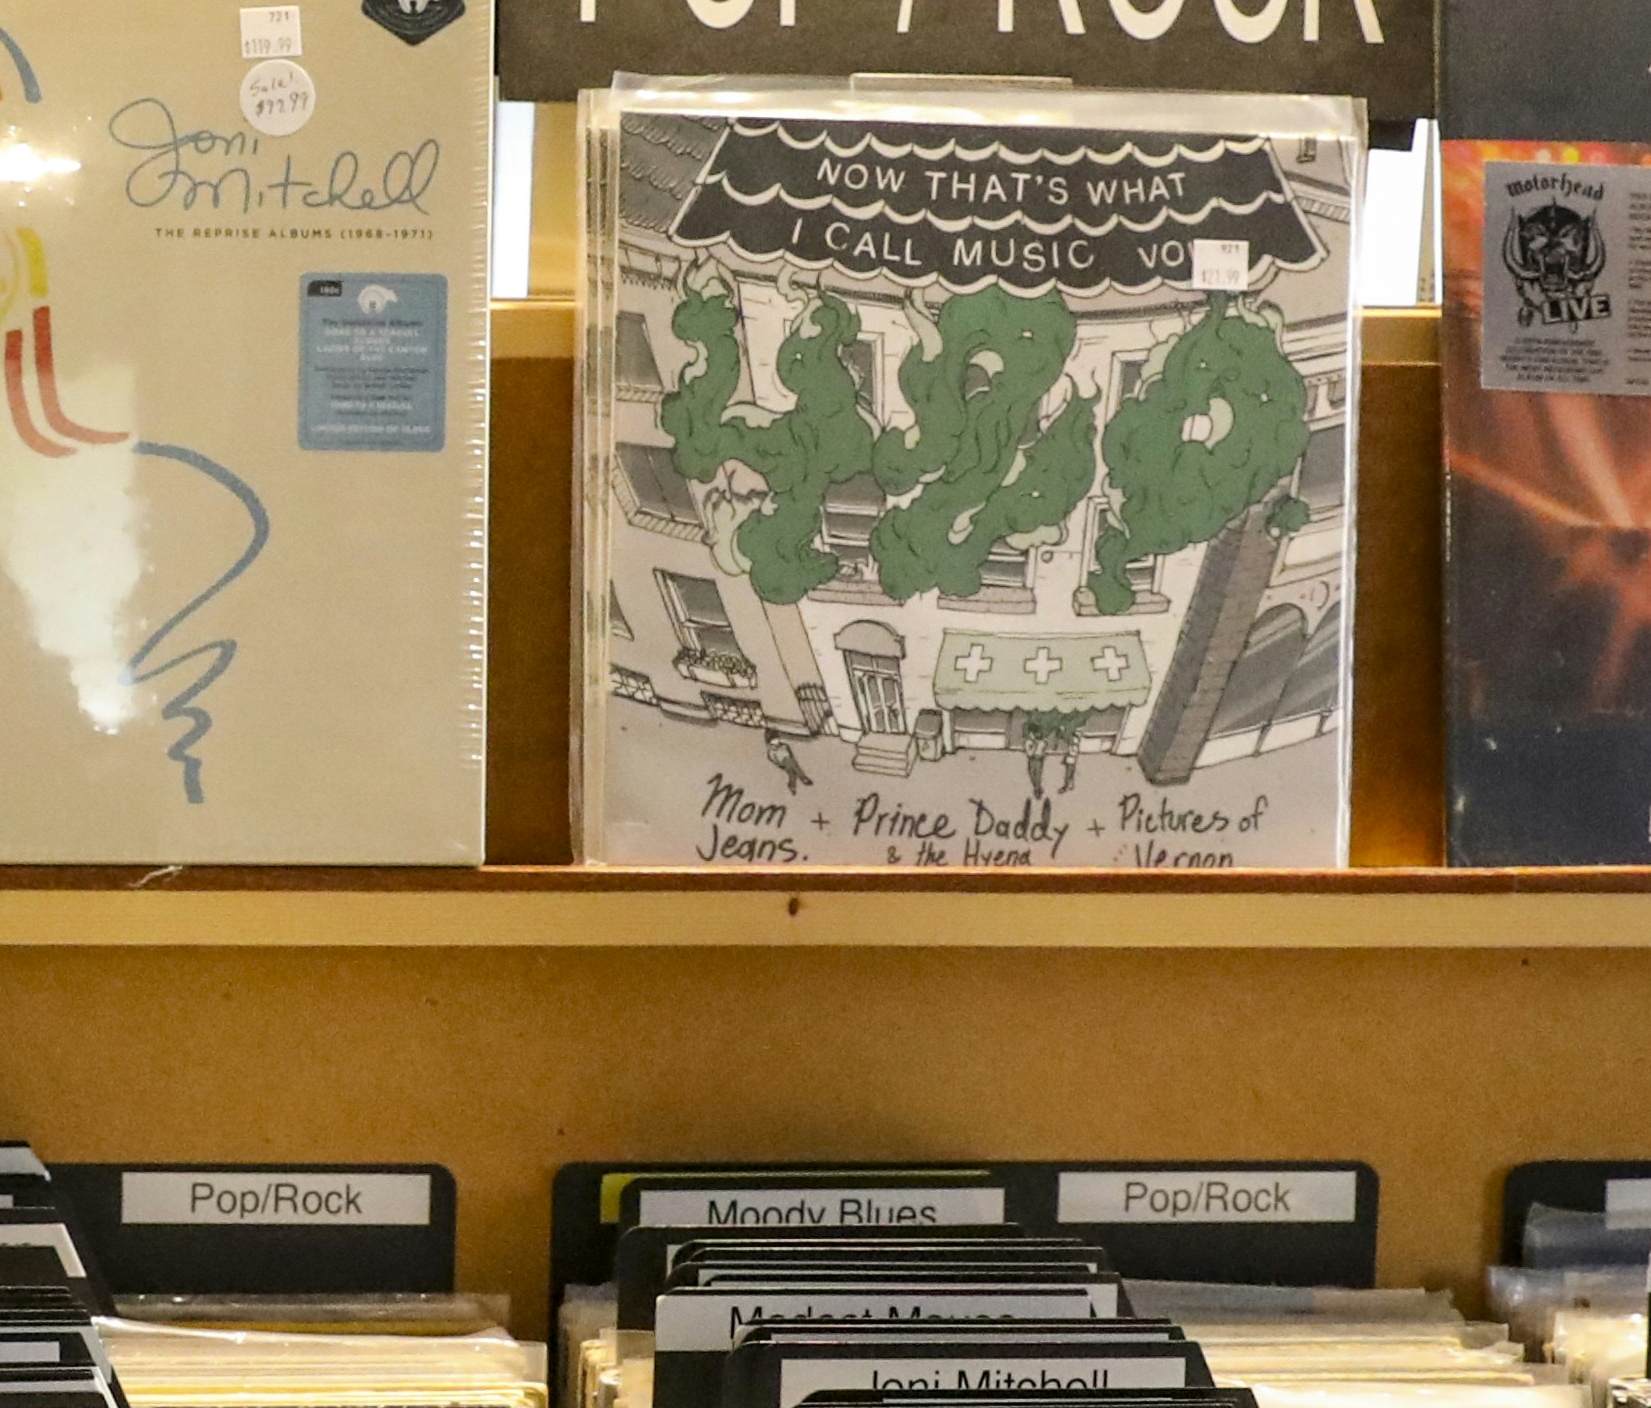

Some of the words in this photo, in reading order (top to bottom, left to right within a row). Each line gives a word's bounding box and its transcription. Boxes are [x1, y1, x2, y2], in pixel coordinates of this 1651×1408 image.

[157, 137, 443, 217] Mitchell
[815, 157, 908, 201] NOW
[925, 168, 1071, 204] THAT'S
[1086, 170, 1188, 206] WHAT
[155, 226, 186, 240] THE
[192, 226, 262, 240] REPRISE
[268, 226, 334, 241] ALBUMS
[339, 226, 435, 242] (1968-1971)
[791, 216, 805, 246] I
[823, 220, 923, 268] CALL
[950, 238, 1096, 272] MUSIC
[1542, 294, 1613, 325] LIVE
[700, 771, 792, 831] Mom
[852, 794, 958, 844] Prince
[971, 796, 1071, 860] Daddy
[1117, 791, 1232, 837] Pictures
[1238, 794, 1270, 837] of
[915, 842, 950, 864] the
[188, 1181, 363, 1219] Pop/Rock
[1123, 1180, 1292, 1217] Pop/Rock
